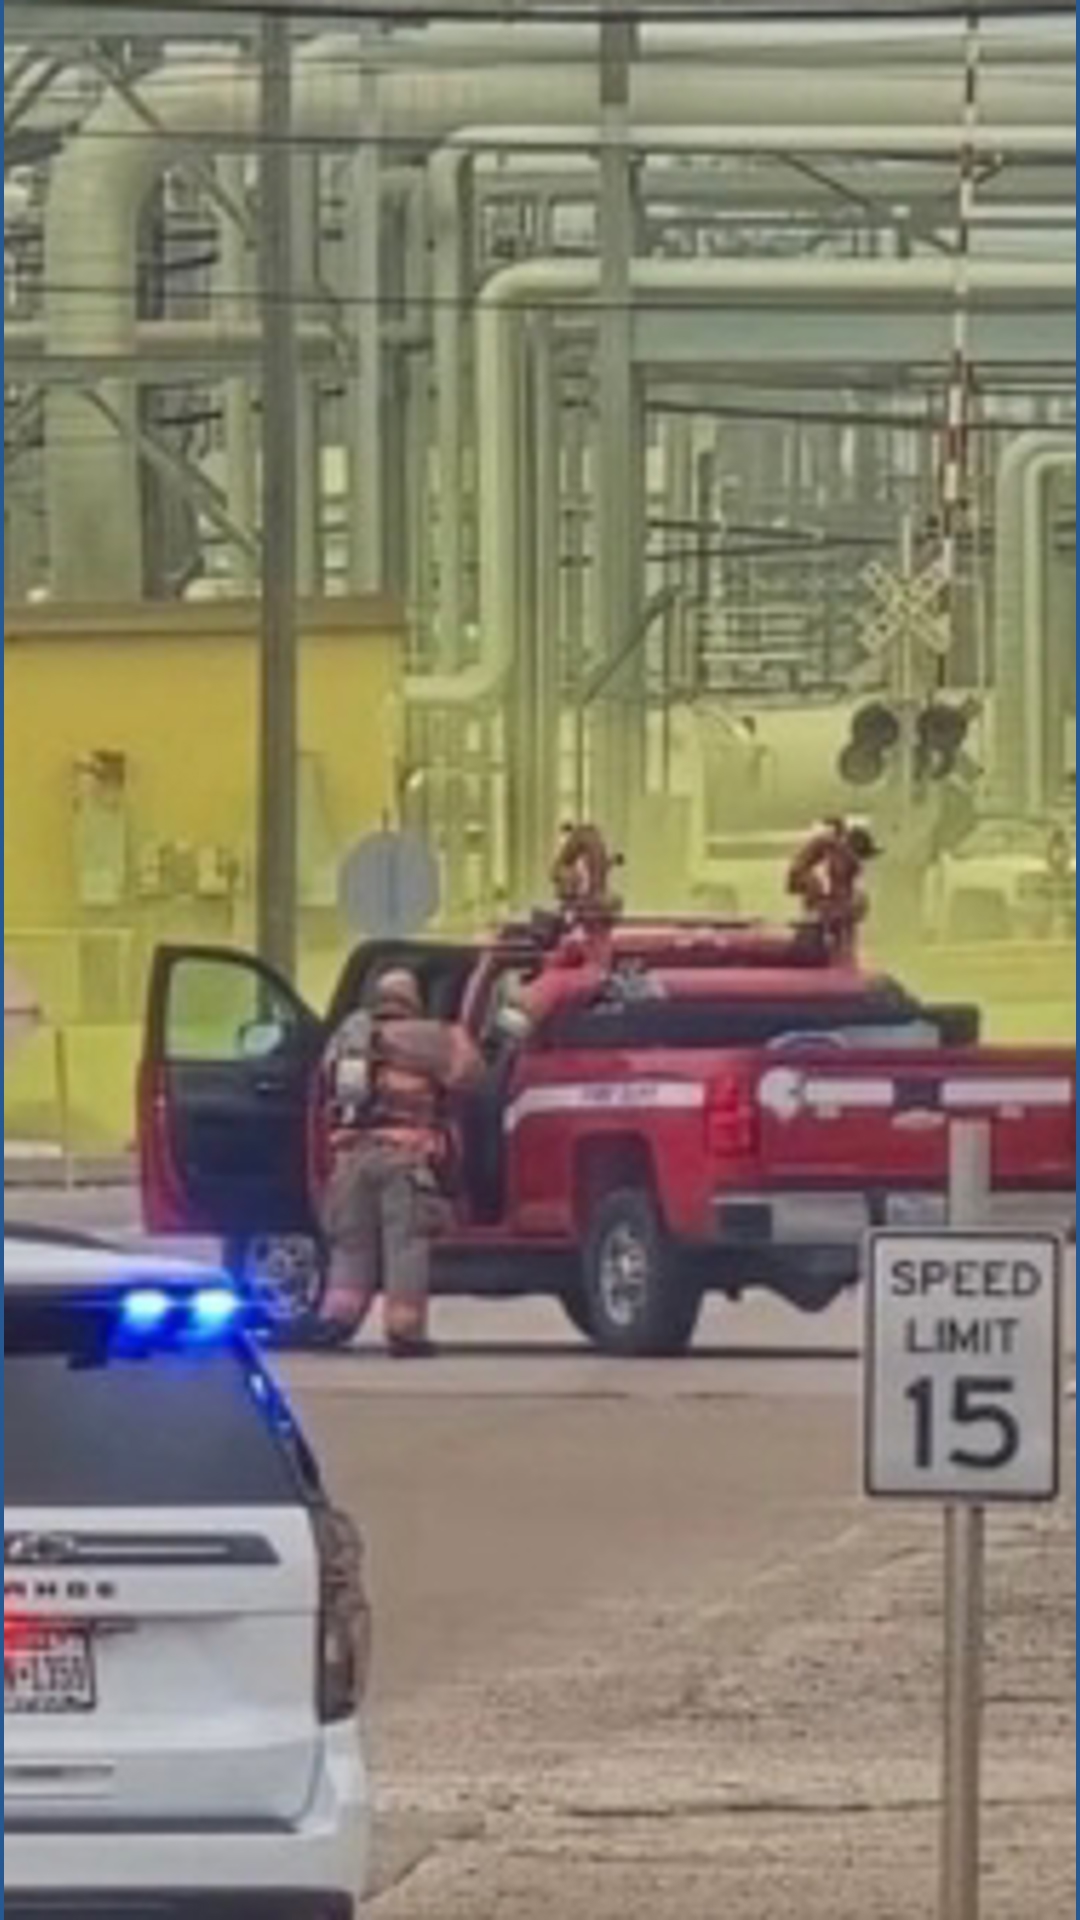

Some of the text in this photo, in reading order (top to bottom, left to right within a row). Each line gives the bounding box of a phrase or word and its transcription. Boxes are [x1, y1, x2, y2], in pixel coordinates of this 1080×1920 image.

[891, 1260, 1042, 1297] SPEED
[905, 1316, 1020, 1353] LIMIT
[904, 1376, 1020, 1470] 15
